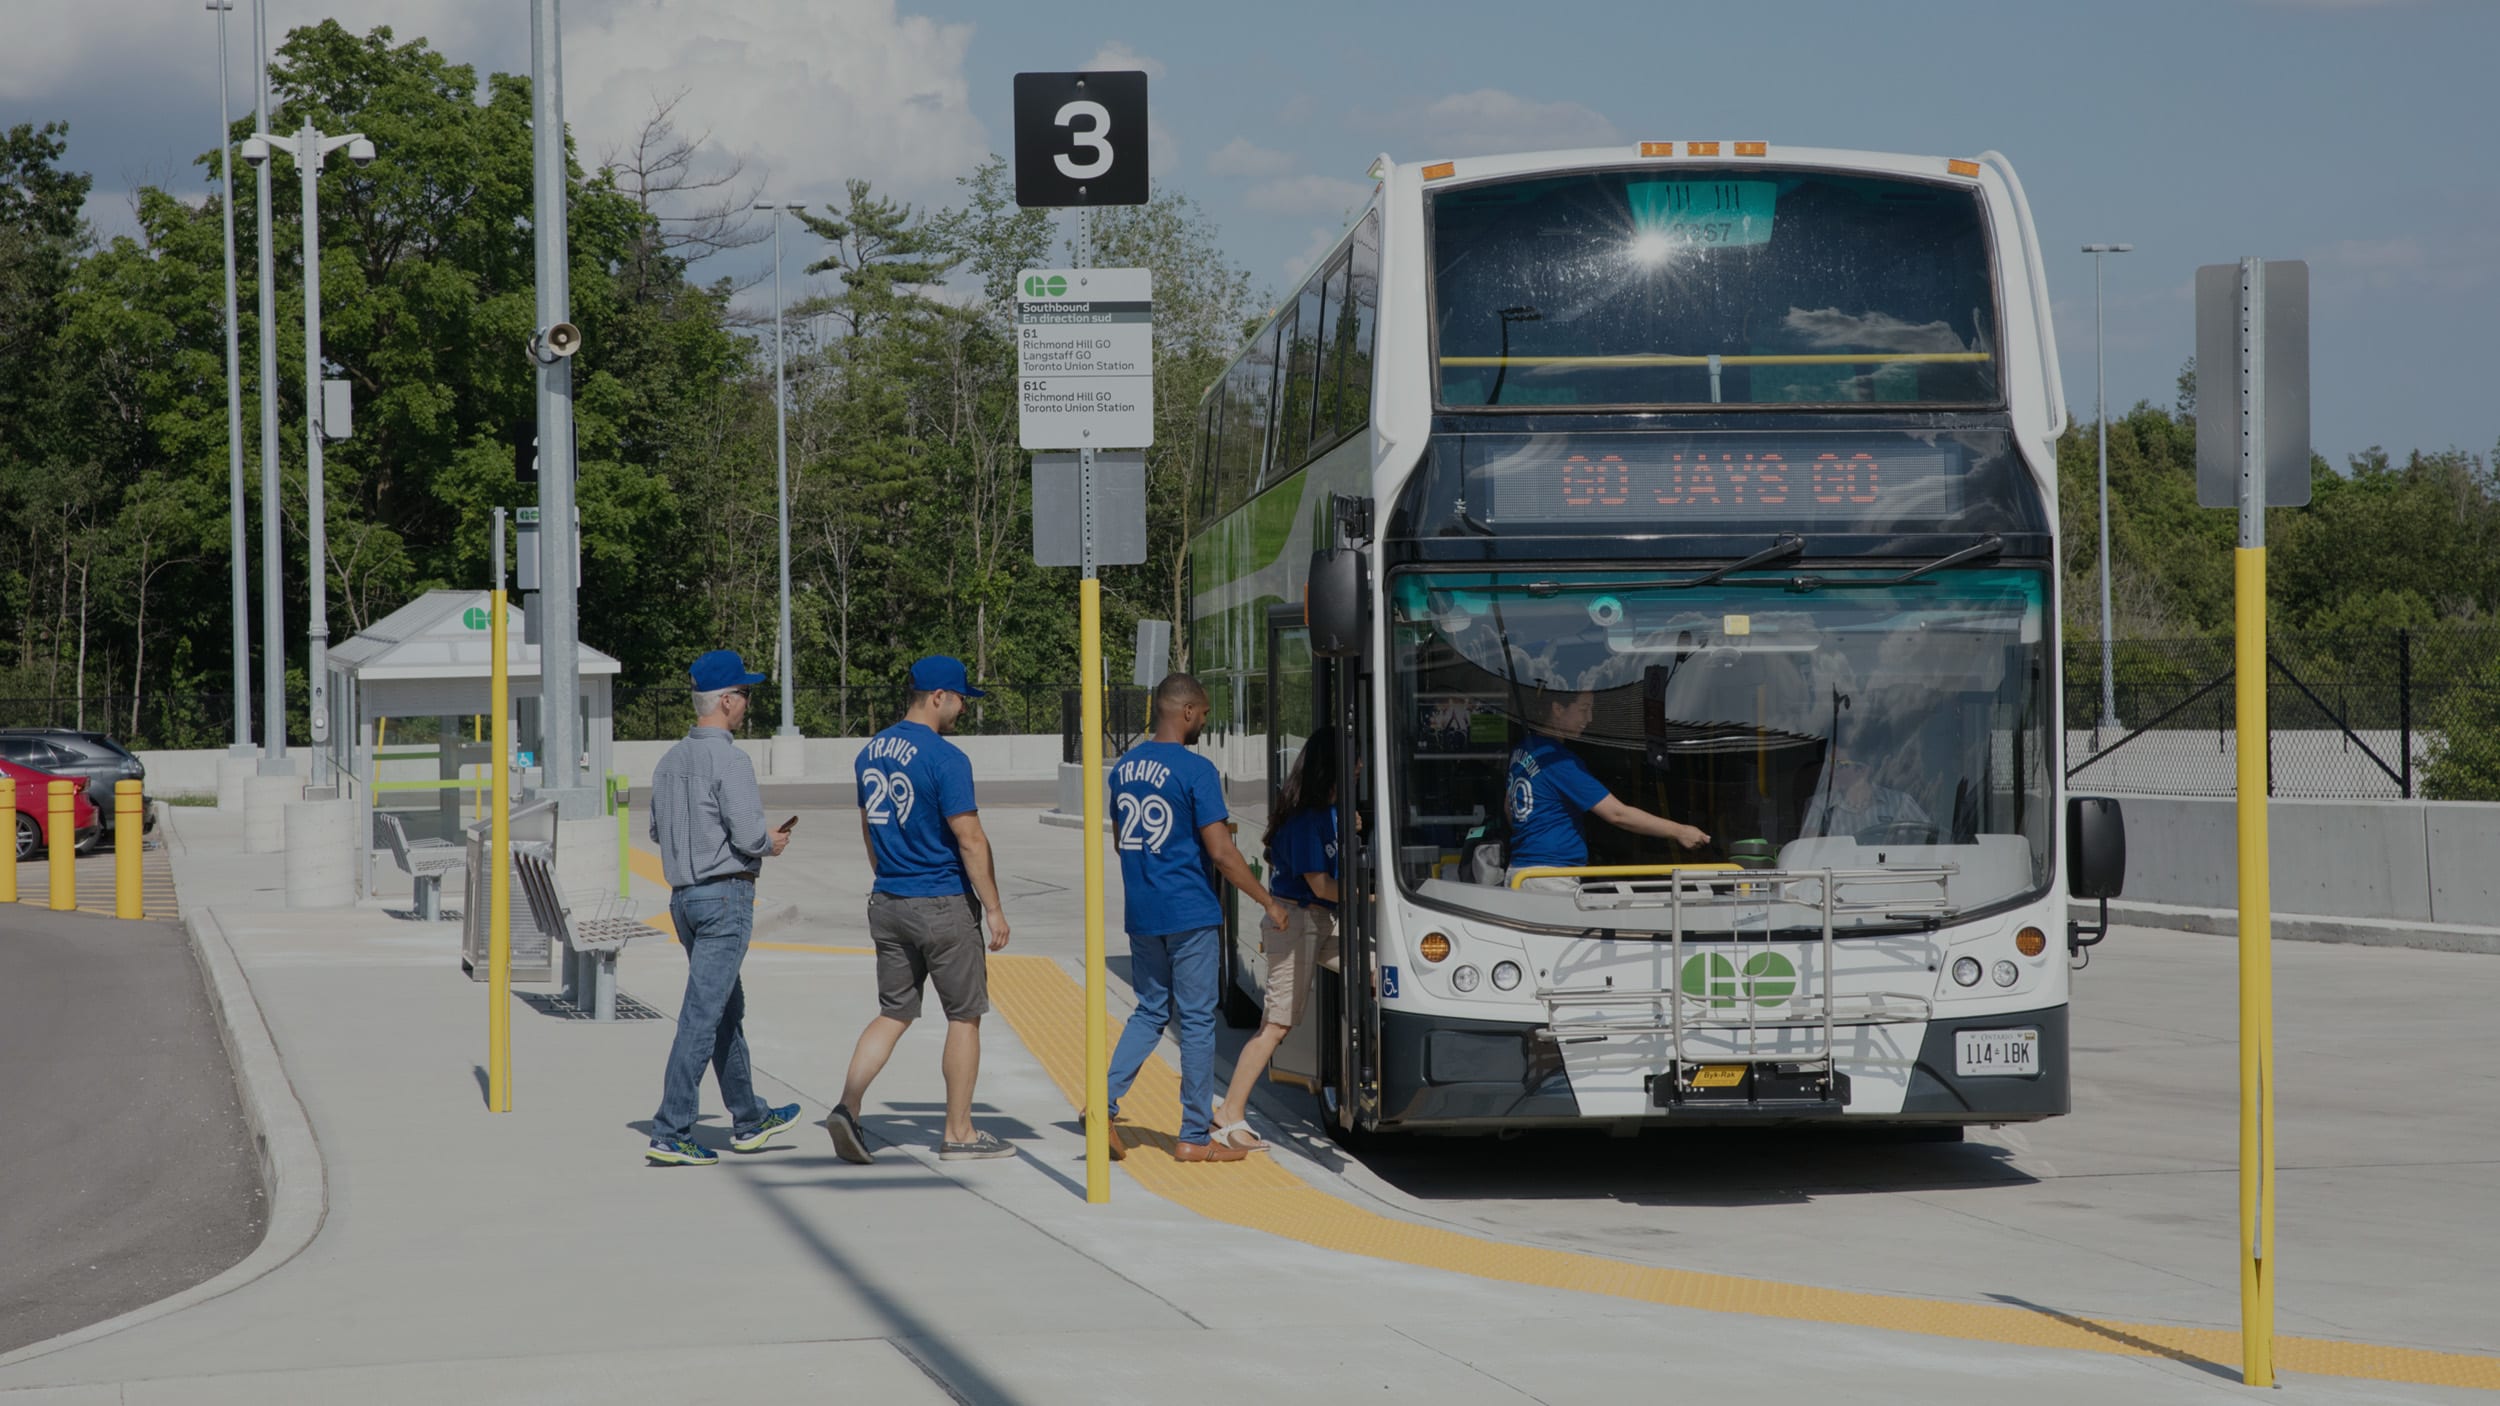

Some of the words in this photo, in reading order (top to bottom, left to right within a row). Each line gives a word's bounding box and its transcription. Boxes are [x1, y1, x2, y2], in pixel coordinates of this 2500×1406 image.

[1053, 100, 1114, 179] 3
[1024, 275, 1068, 297] GO
[1023, 302, 1090, 313] Southbound
[1023, 314, 1037, 323] En
[1040, 314, 1089, 323] direction
[1091, 313, 1112, 322] sud
[1023, 329, 1038, 338] 61
[1023, 340, 1074, 350] Richmond
[1076, 340, 1093, 349] Hill
[1095, 340, 1111, 349] GO
[1023, 351, 1073, 362] Langstaff
[1075, 351, 1092, 360] GO
[1024, 362, 1062, 371] Toronto
[1064, 362, 1094, 371] Union
[1096, 361, 1134, 370] Station
[1023, 381, 1047, 391] 61C
[1024, 392, 1074, 402] Richmond
[1077, 392, 1093, 401] Hill
[1095, 392, 1112, 401] GO
[1024, 403, 1063, 412] Toronto
[1065, 403, 1094, 412] Union
[1097, 402, 1135, 412] Station
[1563, 455, 1628, 505] GO
[1654, 454, 1788, 504] JAYS
[1813, 453, 1879, 503] GO
[868, 737, 918, 766] TRAVIS
[1118, 760, 1170, 789] TRAVIS
[862, 768, 915, 826] 29
[1117, 792, 1173, 851] 29
[1681, 951, 1797, 1008] GO
[1966, 1043, 1992, 1064] 114
[2004, 1043, 2029, 1063] 1BK
